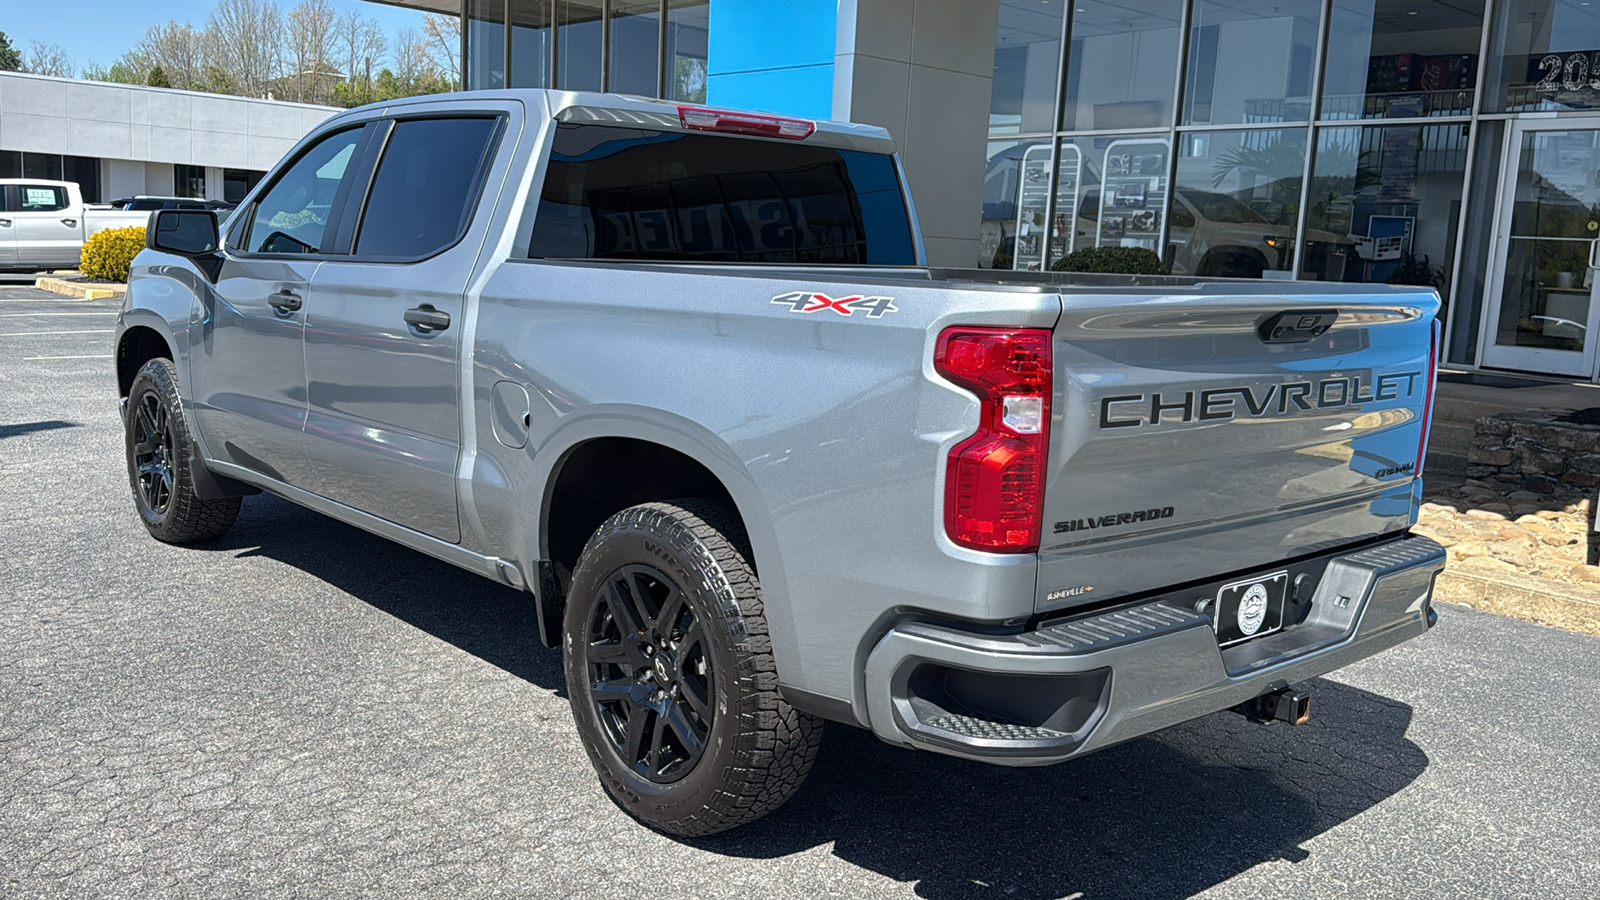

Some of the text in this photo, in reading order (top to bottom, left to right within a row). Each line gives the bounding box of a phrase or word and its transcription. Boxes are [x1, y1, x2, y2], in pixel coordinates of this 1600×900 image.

[1099, 371, 1421, 430] CHEVROLET
[1053, 506, 1175, 534] SILVERADO
[1046, 585, 1084, 601] ASHEVILLE
